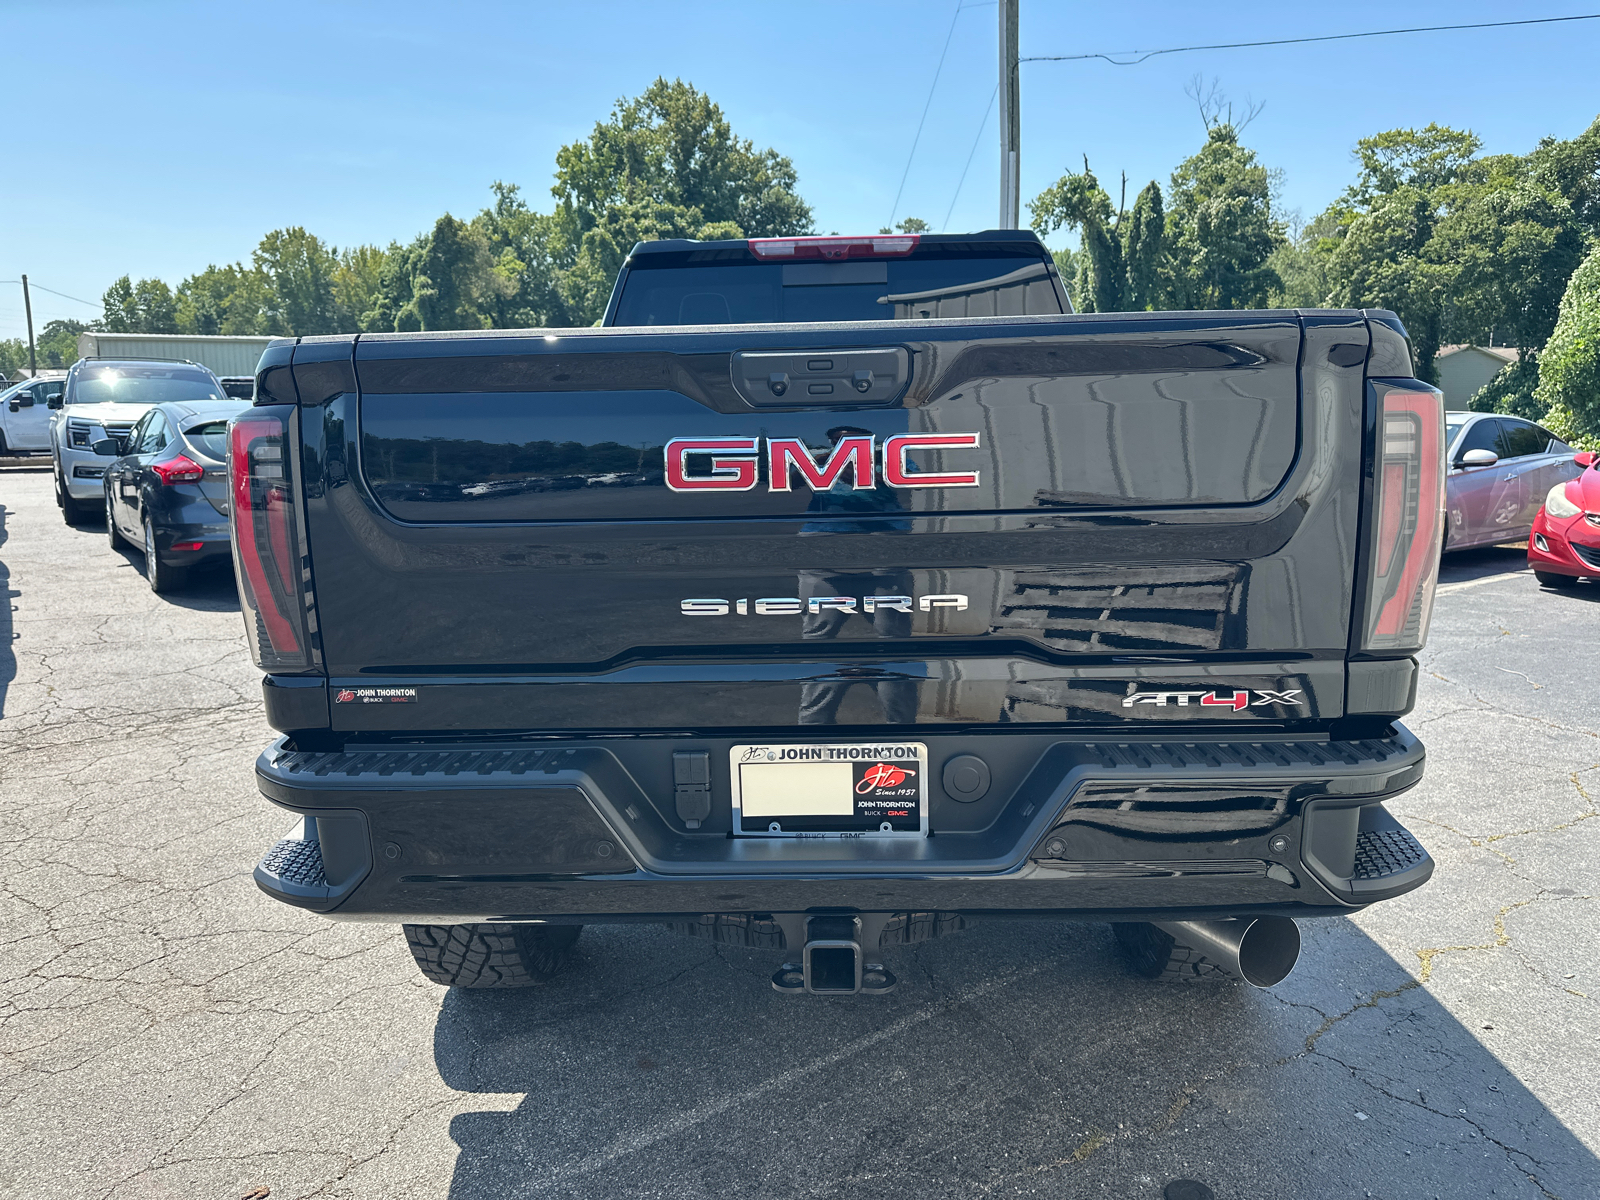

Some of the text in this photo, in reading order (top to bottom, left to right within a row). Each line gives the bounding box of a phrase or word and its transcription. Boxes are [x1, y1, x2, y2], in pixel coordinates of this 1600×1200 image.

[663, 431, 981, 494] GMC
[680, 594, 969, 616] SIERRA
[778, 746, 918, 760] JOHN THORNTON
[875, 788, 916, 796] Since 1957
